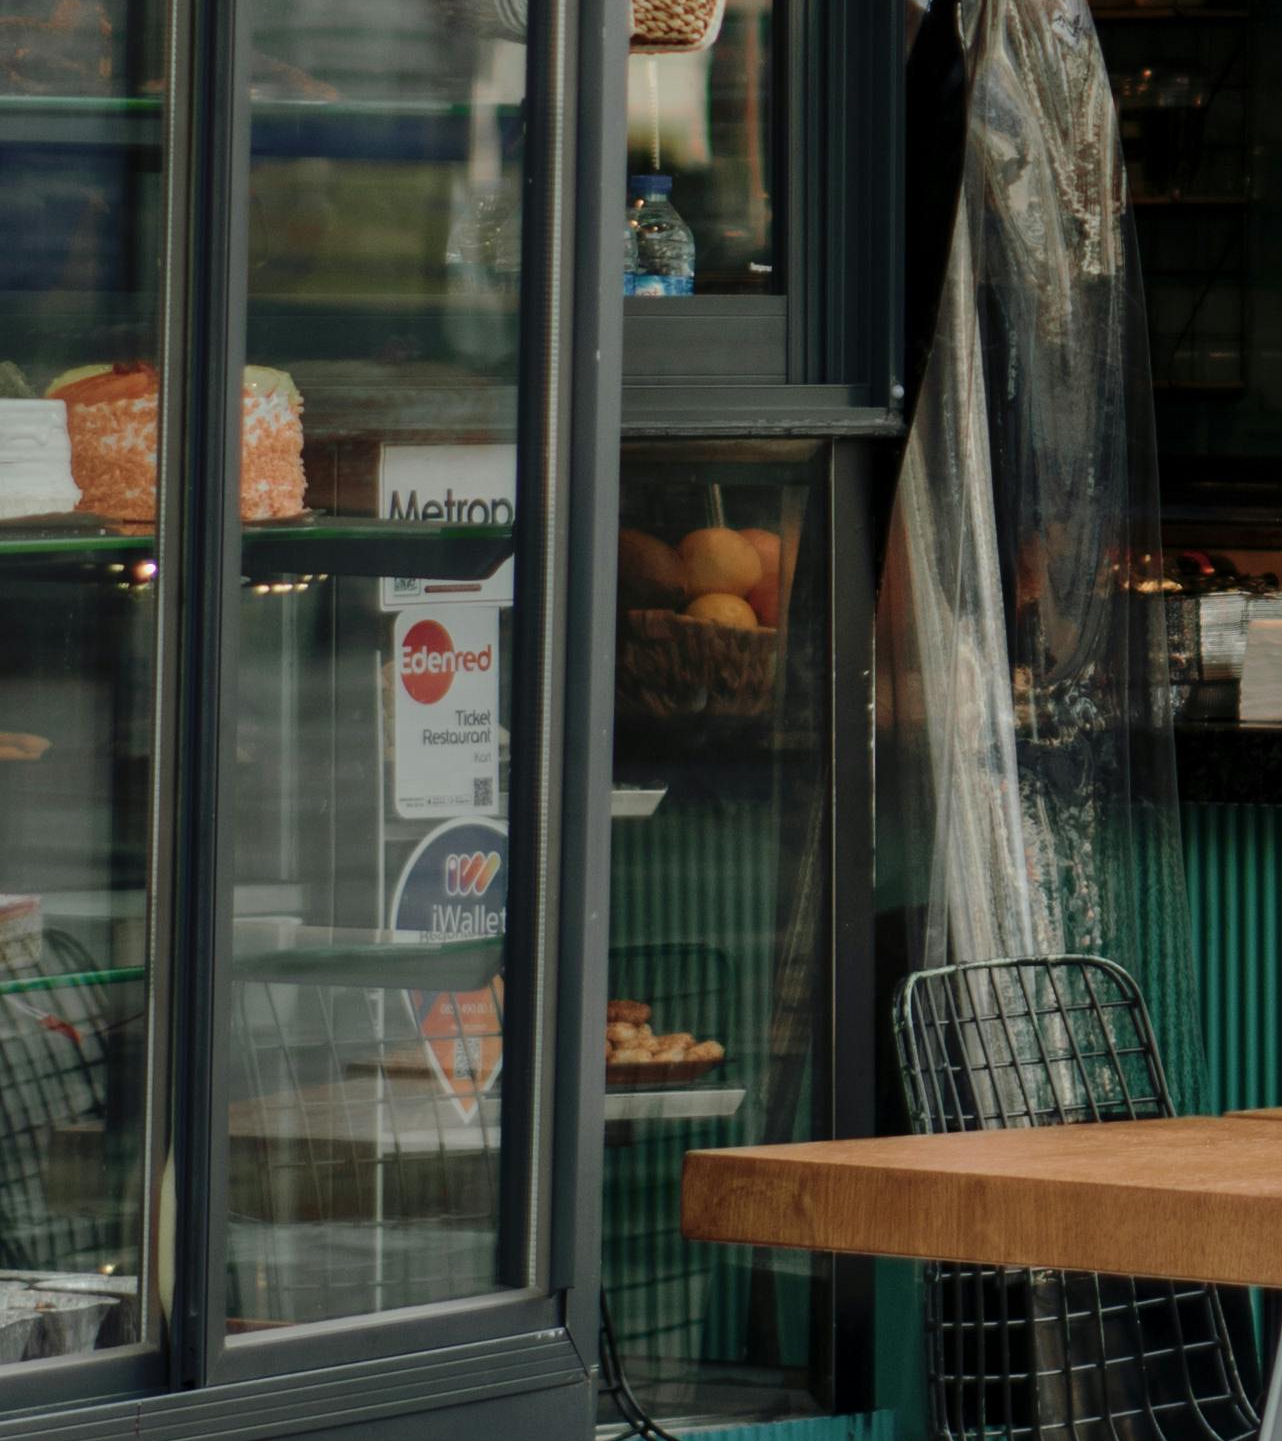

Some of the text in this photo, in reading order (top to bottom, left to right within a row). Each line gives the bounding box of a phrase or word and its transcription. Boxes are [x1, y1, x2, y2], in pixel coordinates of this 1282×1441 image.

[388, 487, 515, 526] Metrop
[401, 643, 493, 675] Edenred
[456, 708, 491, 727] Ticket
[422, 727, 492, 746] Restaurant
[432, 903, 508, 935] iWallet
